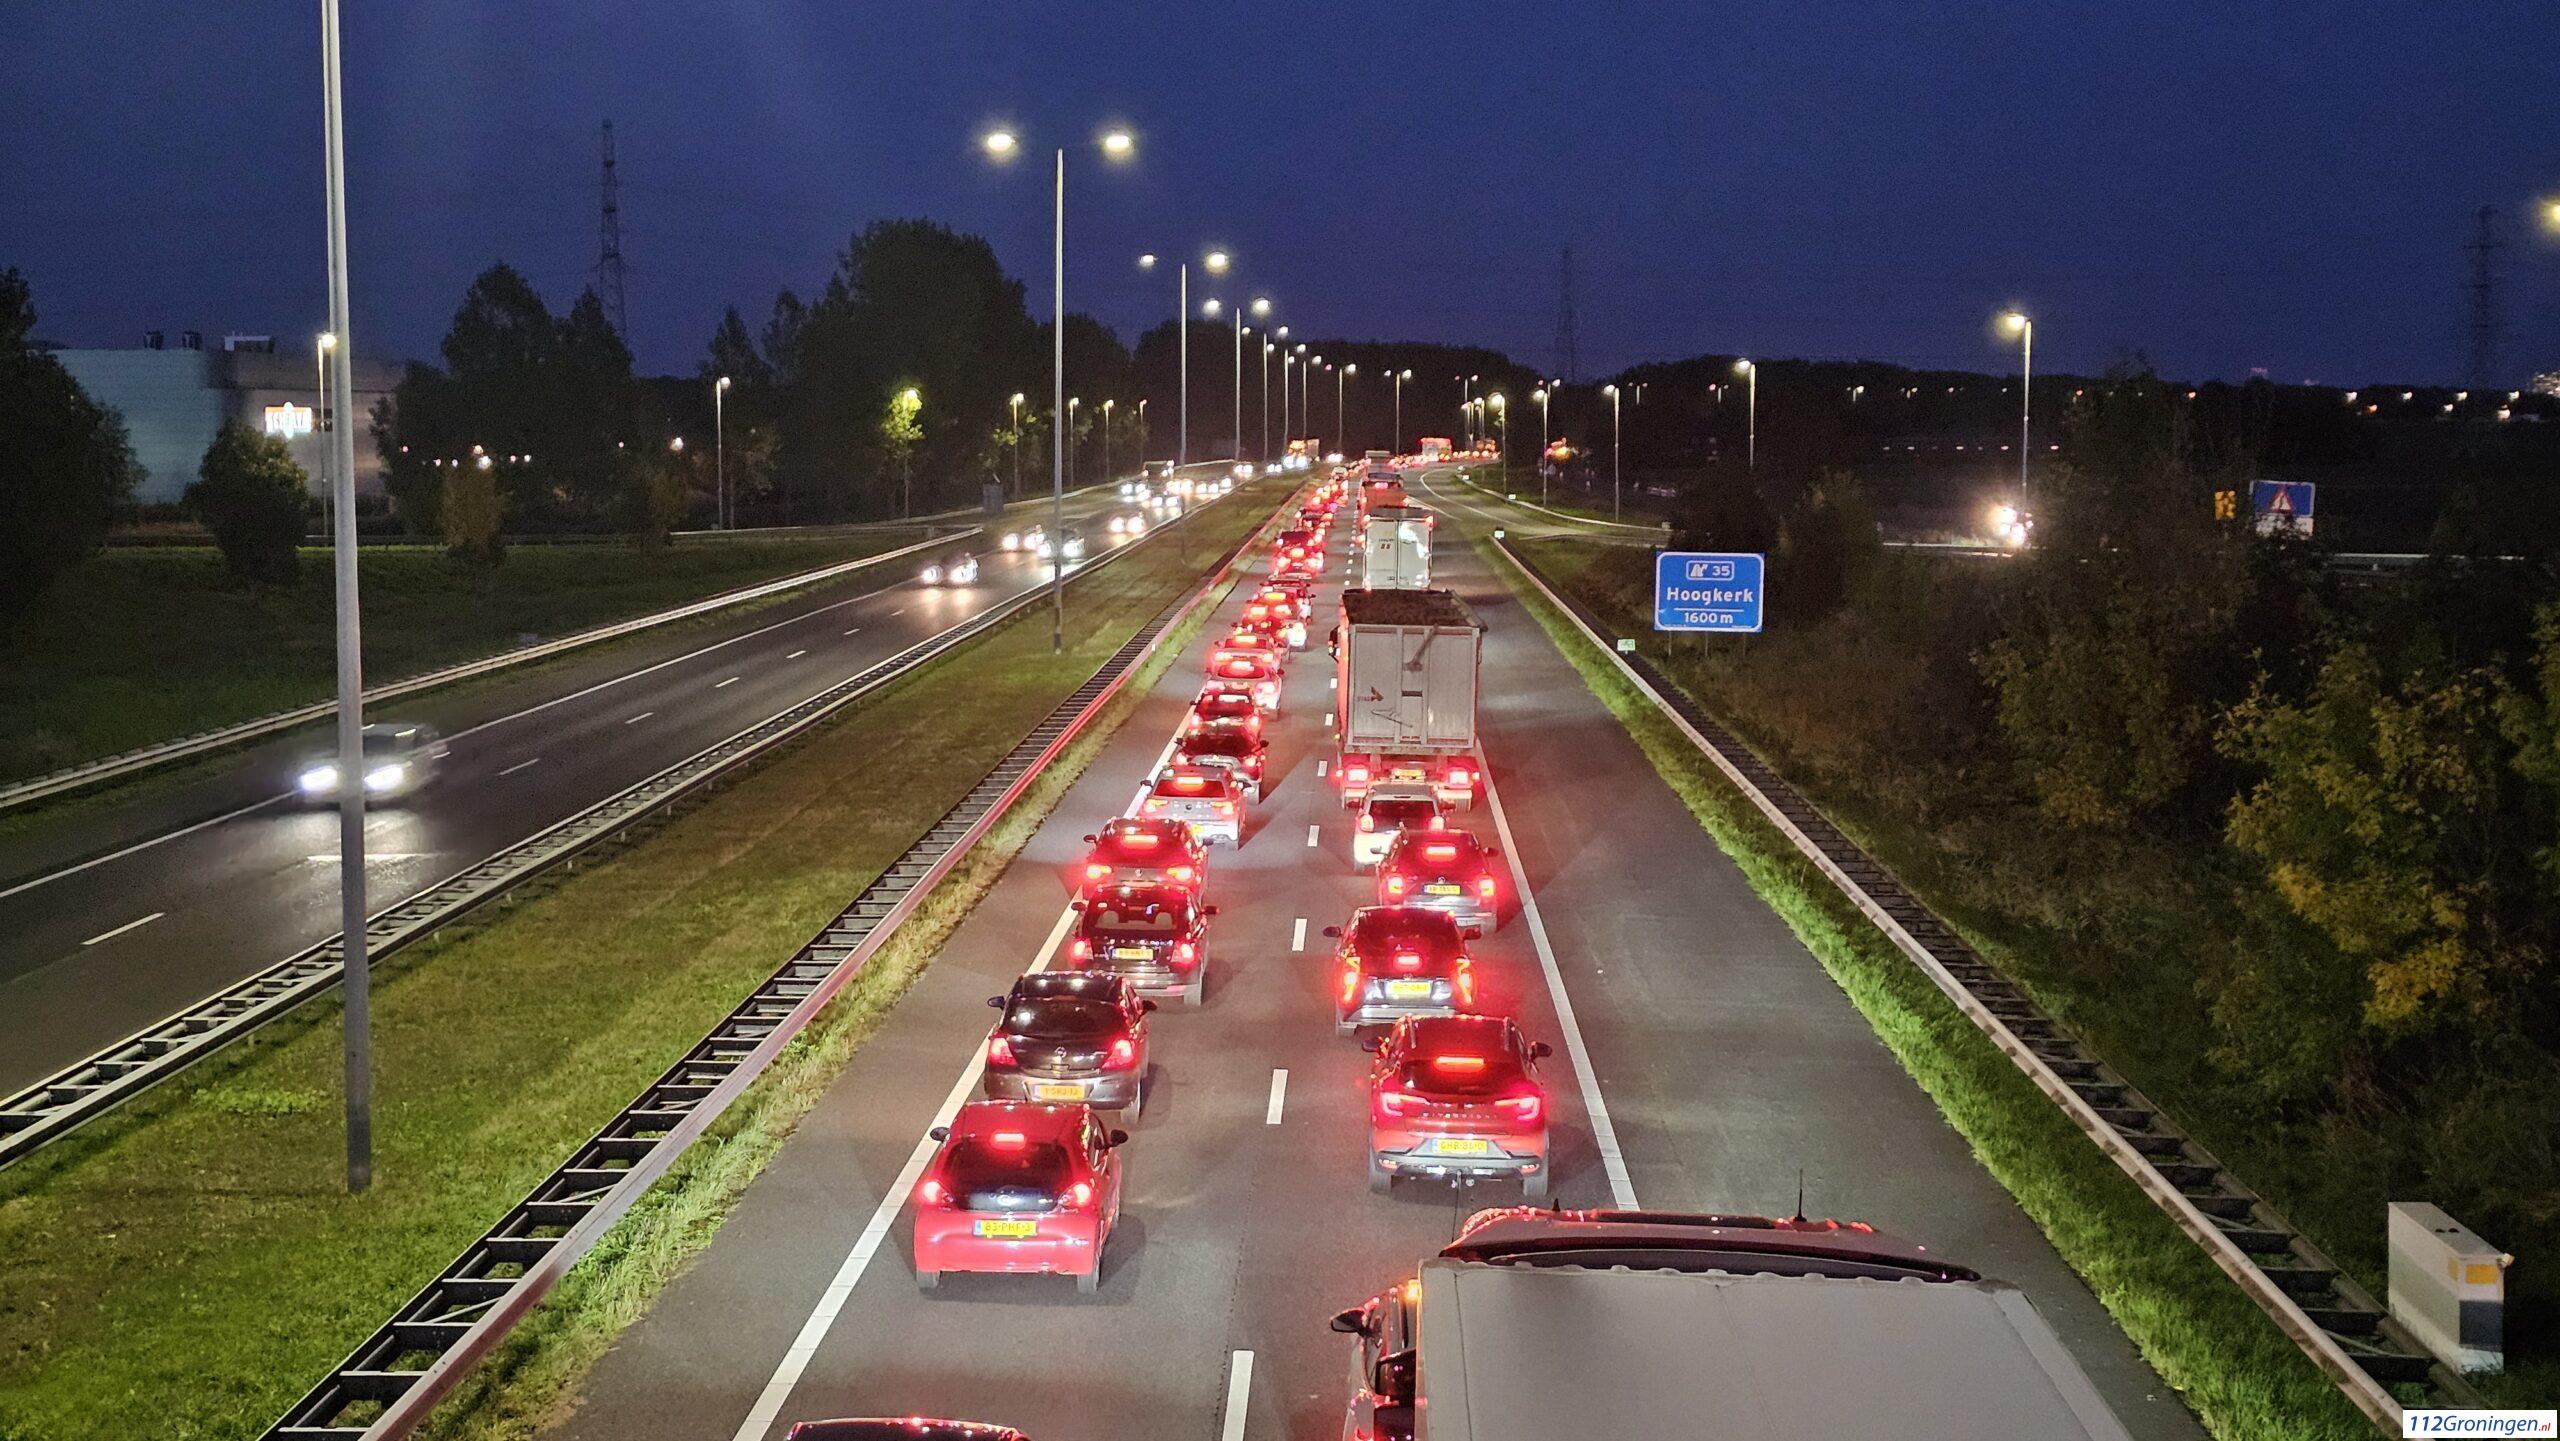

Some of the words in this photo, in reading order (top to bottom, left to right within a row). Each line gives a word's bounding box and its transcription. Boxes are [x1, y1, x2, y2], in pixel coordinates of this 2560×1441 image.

[1712, 565, 1731, 576] 35
[1666, 586, 1753, 606] Hoogkerk
[1684, 612, 1718, 623] 1600
[1720, 613, 1734, 624] m
